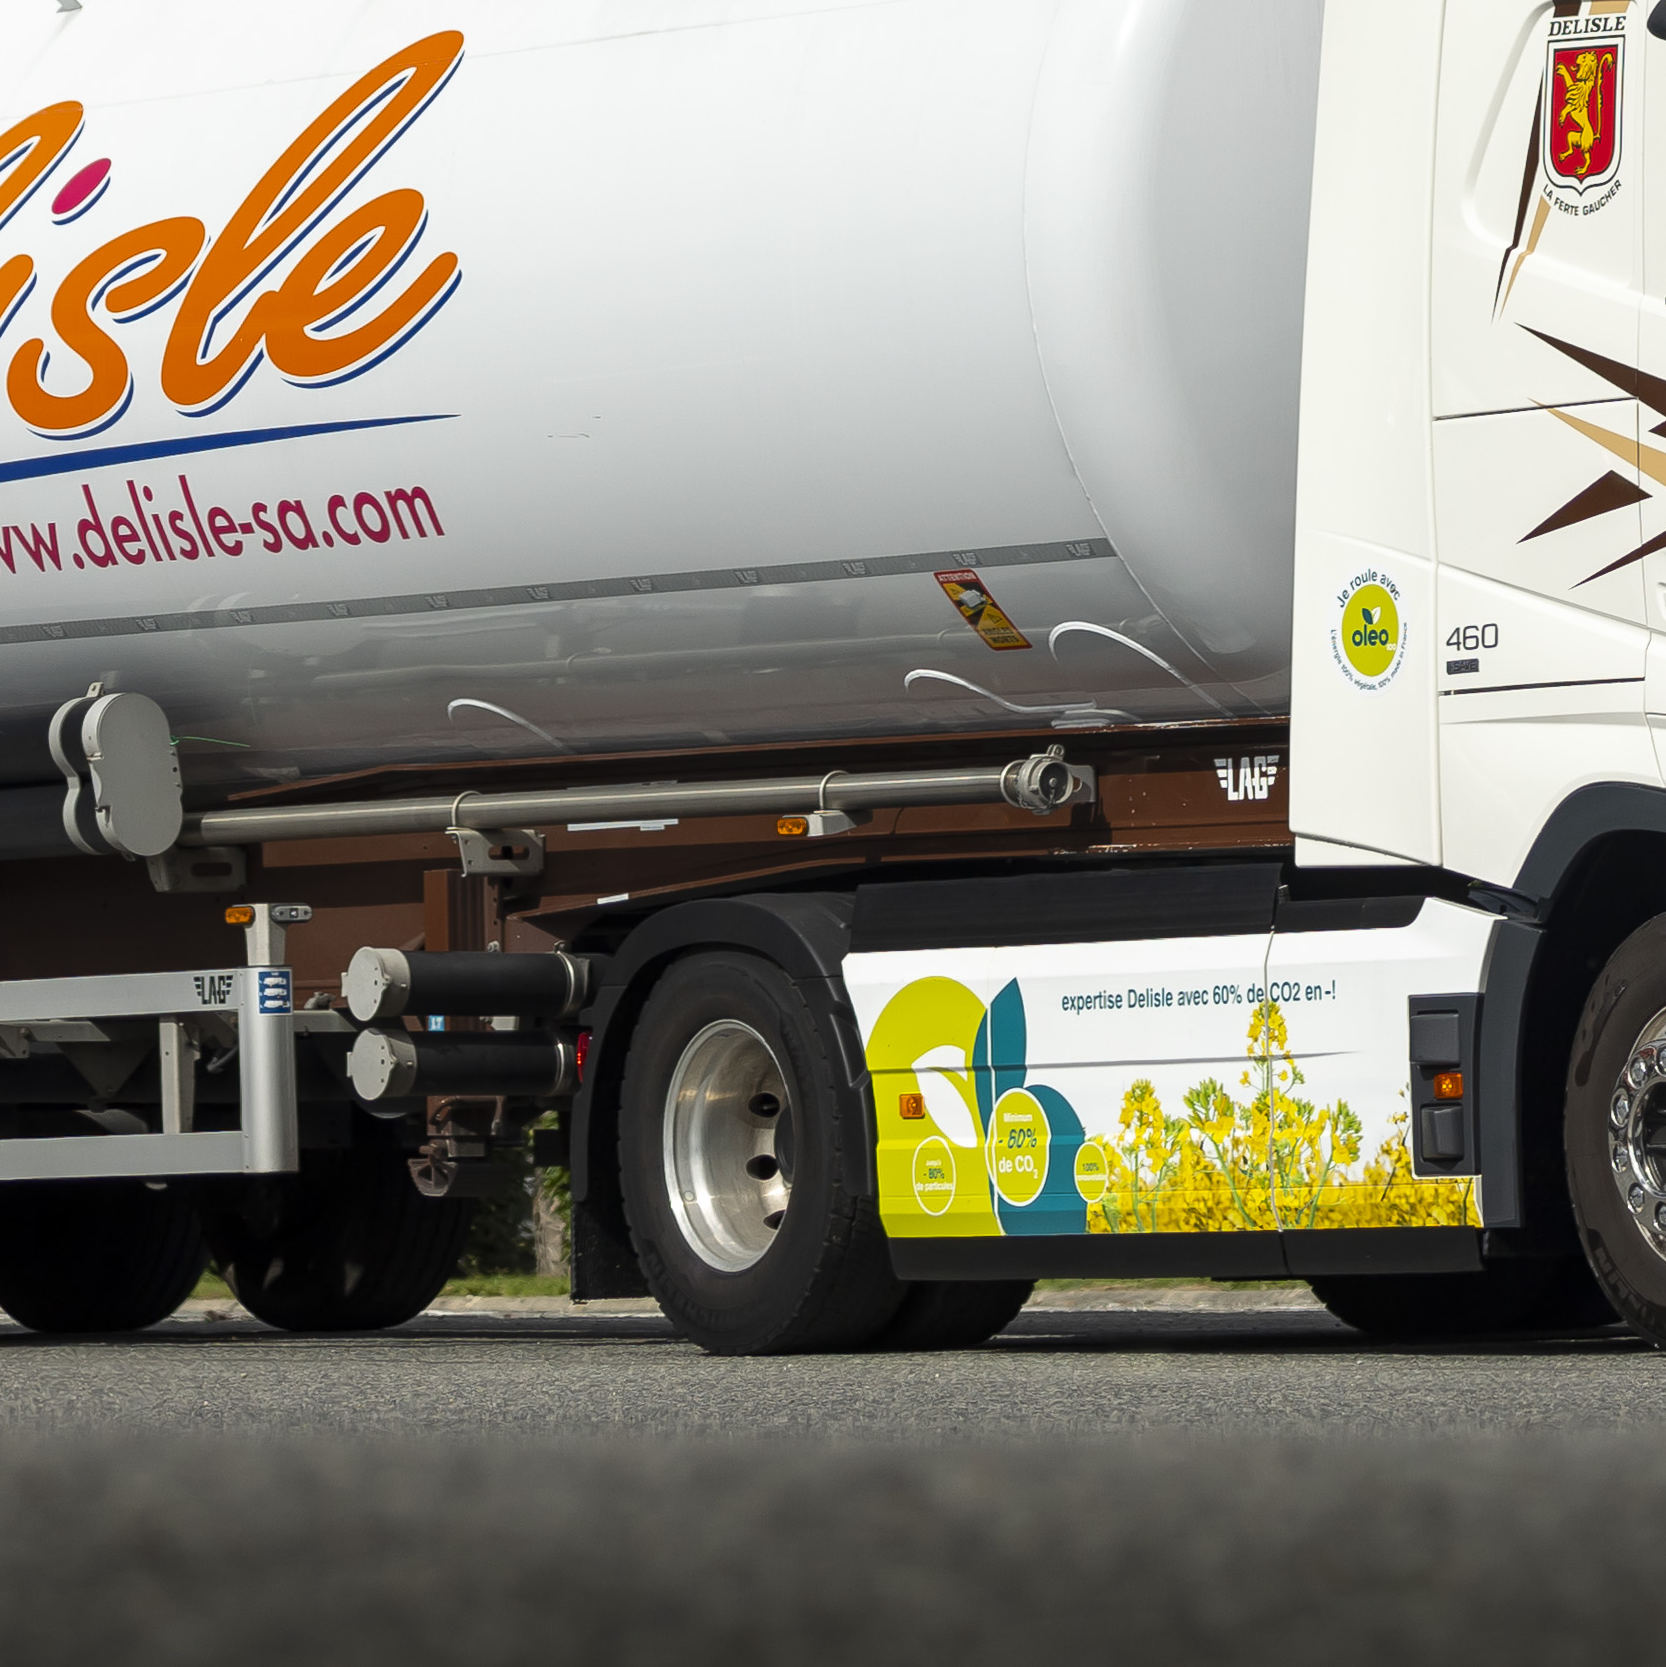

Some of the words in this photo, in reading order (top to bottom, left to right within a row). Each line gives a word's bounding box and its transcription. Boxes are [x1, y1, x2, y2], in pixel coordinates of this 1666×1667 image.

[1548, 16, 1627, 36] DELISLE
[1542, 183, 1553, 201] LA
[1553, 196, 1580, 217] FERTE
[1582, 179, 1623, 216] GAUCHER
[1337, 589, 1350, 608] Je
[1350, 568, 1378, 590] roule
[1380, 574, 1401, 601] avec
[1352, 624, 1389, 647] oleo
[1446, 623, 1499, 651] 460
[1227, 756, 1269, 801] LAG
[201, 975, 226, 1004] LAG
[1061, 990, 1123, 1015] expertise
[1127, 987, 1173, 1009] Delisle
[1177, 989, 1209, 1006] avec
[1213, 984, 1242, 1005] 60%
[1247, 983, 1265, 1004] de
[1269, 981, 1301, 1003] CO2
[1305, 985, 1322, 1001] en
[1007, 1128, 1037, 1149] 60%
[998, 1156, 1013, 1173] de
[1014, 1155, 1038, 1179] CO2
